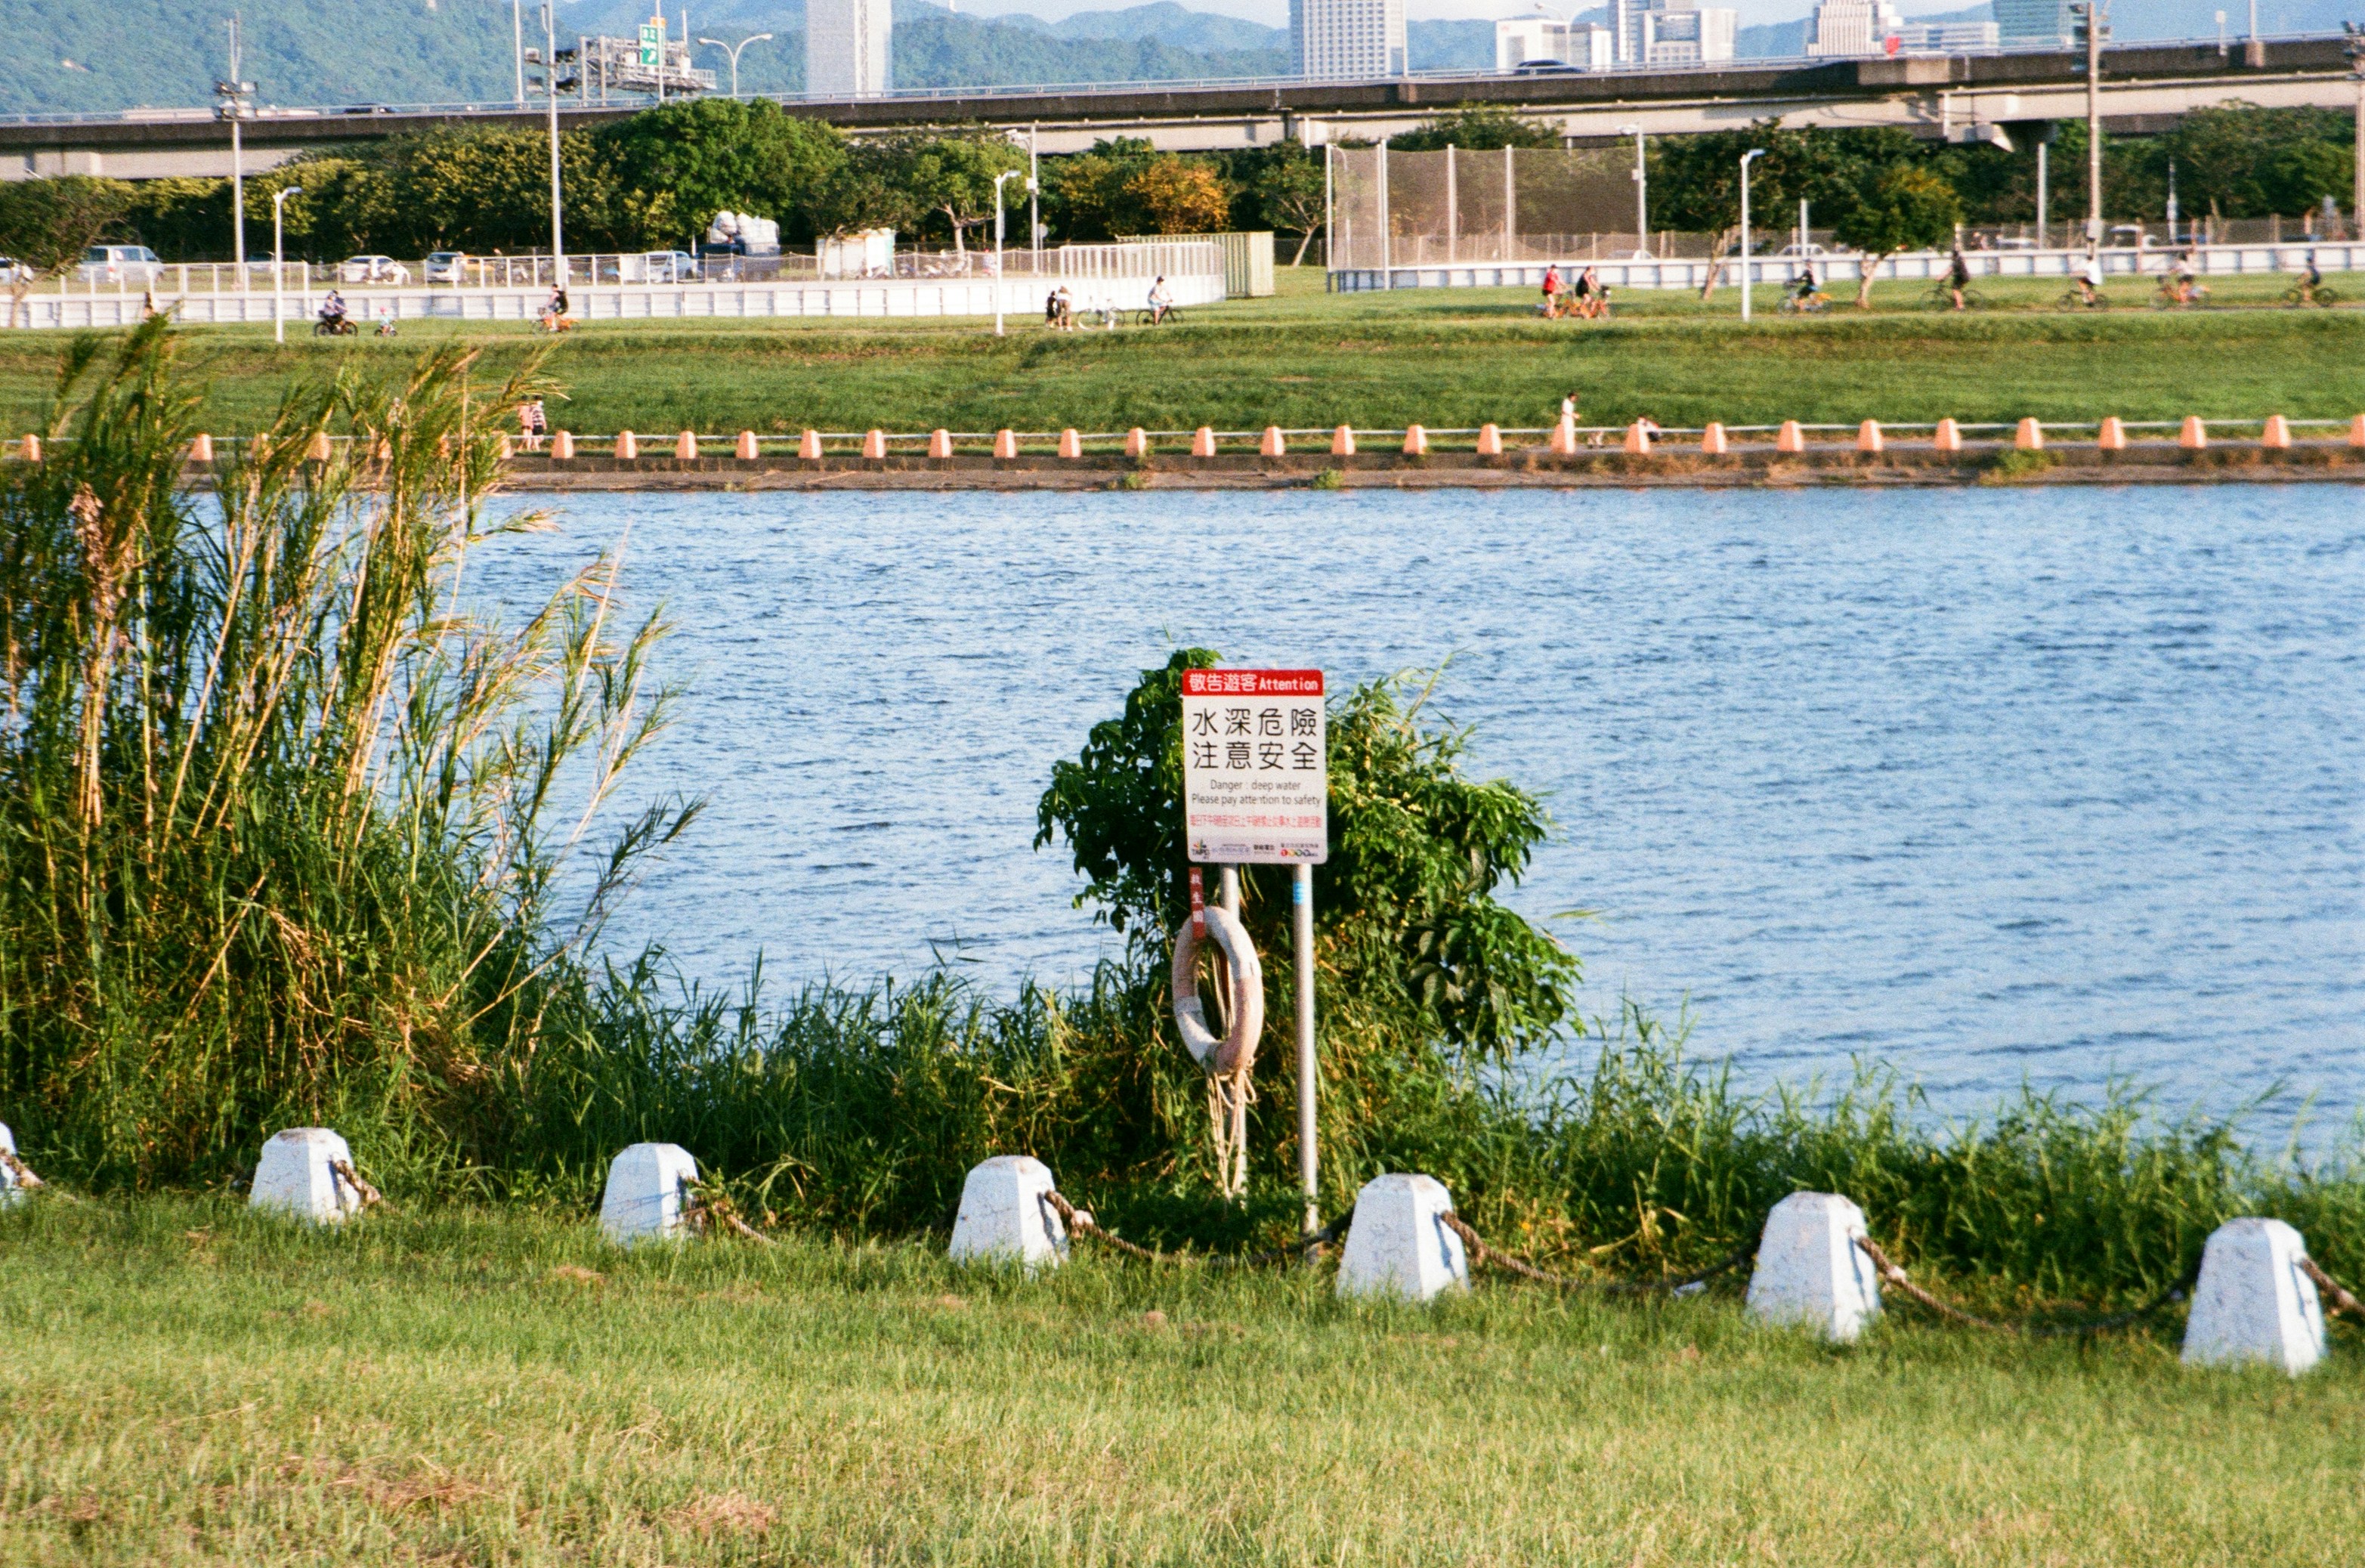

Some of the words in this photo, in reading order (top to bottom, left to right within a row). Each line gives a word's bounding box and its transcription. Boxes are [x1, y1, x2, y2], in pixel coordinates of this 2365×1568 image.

[1189, 673, 1257, 691] 敬告遊客
[1259, 677, 1318, 691] Attention
[1192, 708, 1317, 737] 水深危險
[1193, 741, 1317, 770] 注意安全
[1251, 780, 1273, 792] deep
[1276, 781, 1300, 790] water
[1192, 793, 1219, 804] Please
[1221, 796, 1237, 806] pay
[1239, 794, 1280, 805] attention
[1282, 795, 1291, 805] to
[1294, 795, 1321, 806] safety
